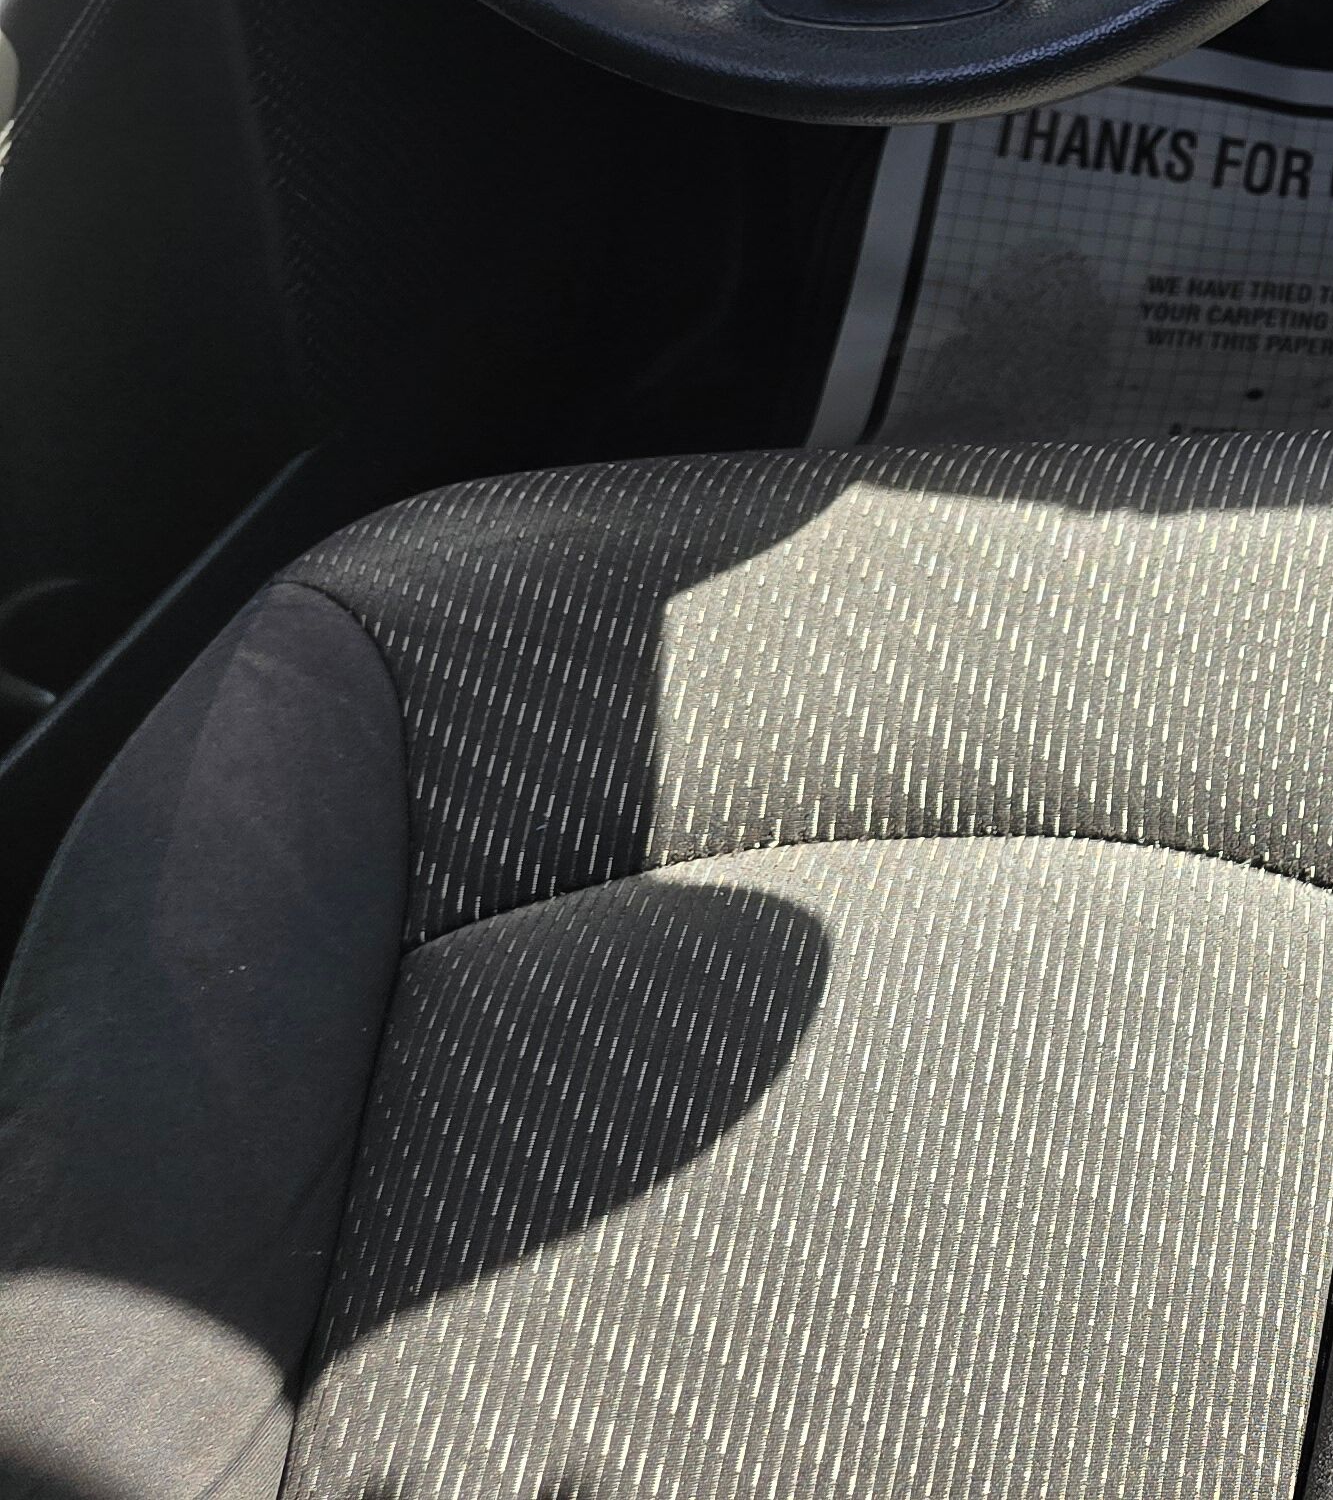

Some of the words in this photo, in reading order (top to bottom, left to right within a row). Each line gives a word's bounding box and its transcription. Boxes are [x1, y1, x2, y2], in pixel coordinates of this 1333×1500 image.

[993, 108, 1199, 184] THANKS
[1212, 137, 1312, 202] FOR
[1148, 275, 1183, 297] WE
[1187, 278, 1244, 299] HAVE
[1248, 281, 1315, 304] TRIED
[1142, 302, 1201, 324] YOUR
[1207, 306, 1328, 332] CARPETING
[1147, 327, 1205, 348] WITH
[1209, 331, 1259, 353] THIS
